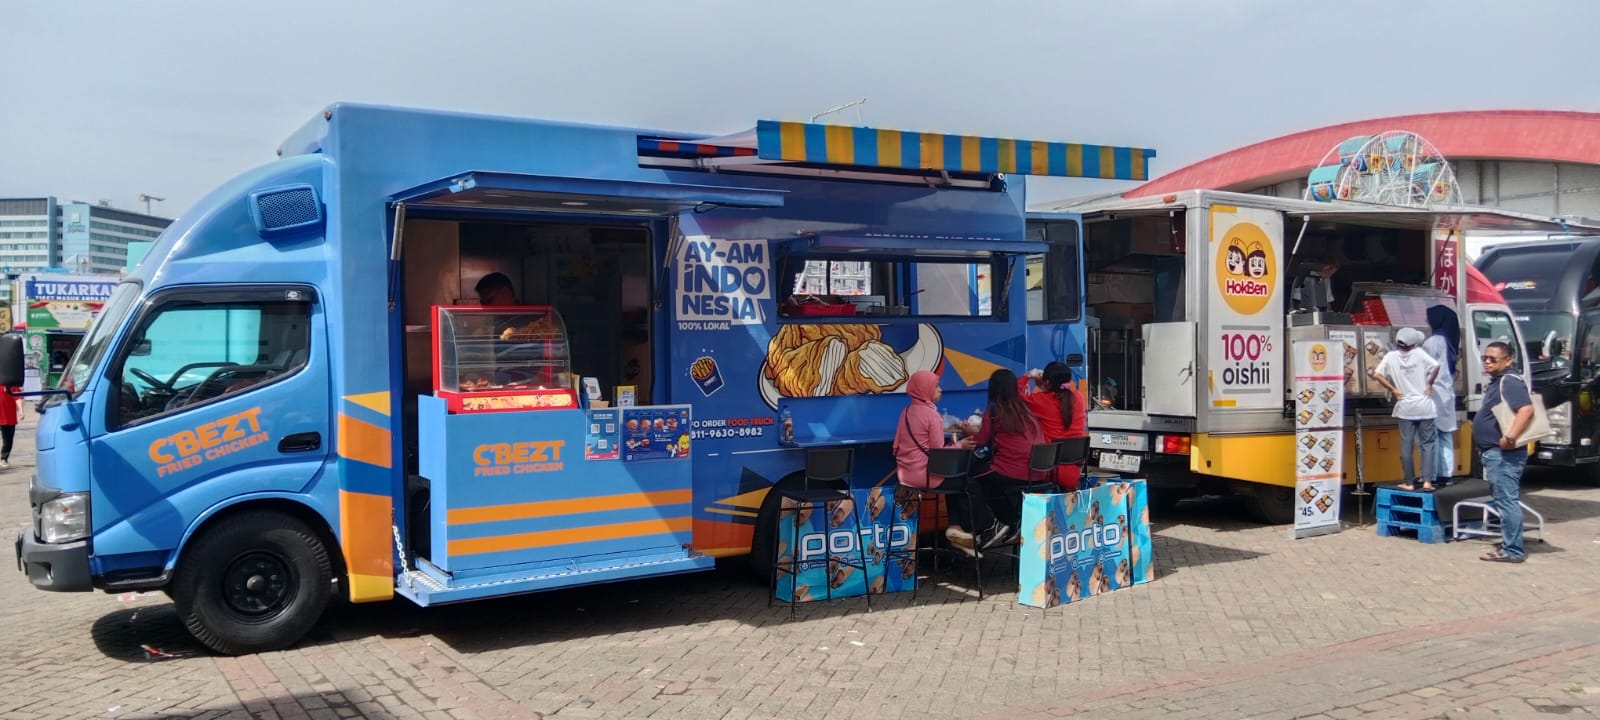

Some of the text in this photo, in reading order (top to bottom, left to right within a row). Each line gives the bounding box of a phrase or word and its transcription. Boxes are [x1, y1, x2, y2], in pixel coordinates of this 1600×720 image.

[684, 241, 763, 264] AY-AM
[1226, 280, 1267, 295] HokBen
[682, 294, 757, 320] NESIA
[678, 322, 730, 331] 100% LOKAL
[1221, 333, 1272, 361] 100%
[1222, 362, 1270, 385] oishii
[149, 407, 261, 463] C'BEZT
[701, 419, 726, 428] ORDER
[728, 418, 748, 426] FOOD
[751, 417, 774, 425] TRUCK
[157, 431, 269, 478] FRIED CHICKEN
[473, 439, 565, 466] C'BEZT
[474, 462, 564, 477] FRIED CHICKEN
[801, 523, 910, 562] porto
[1050, 521, 1121, 565] porto
